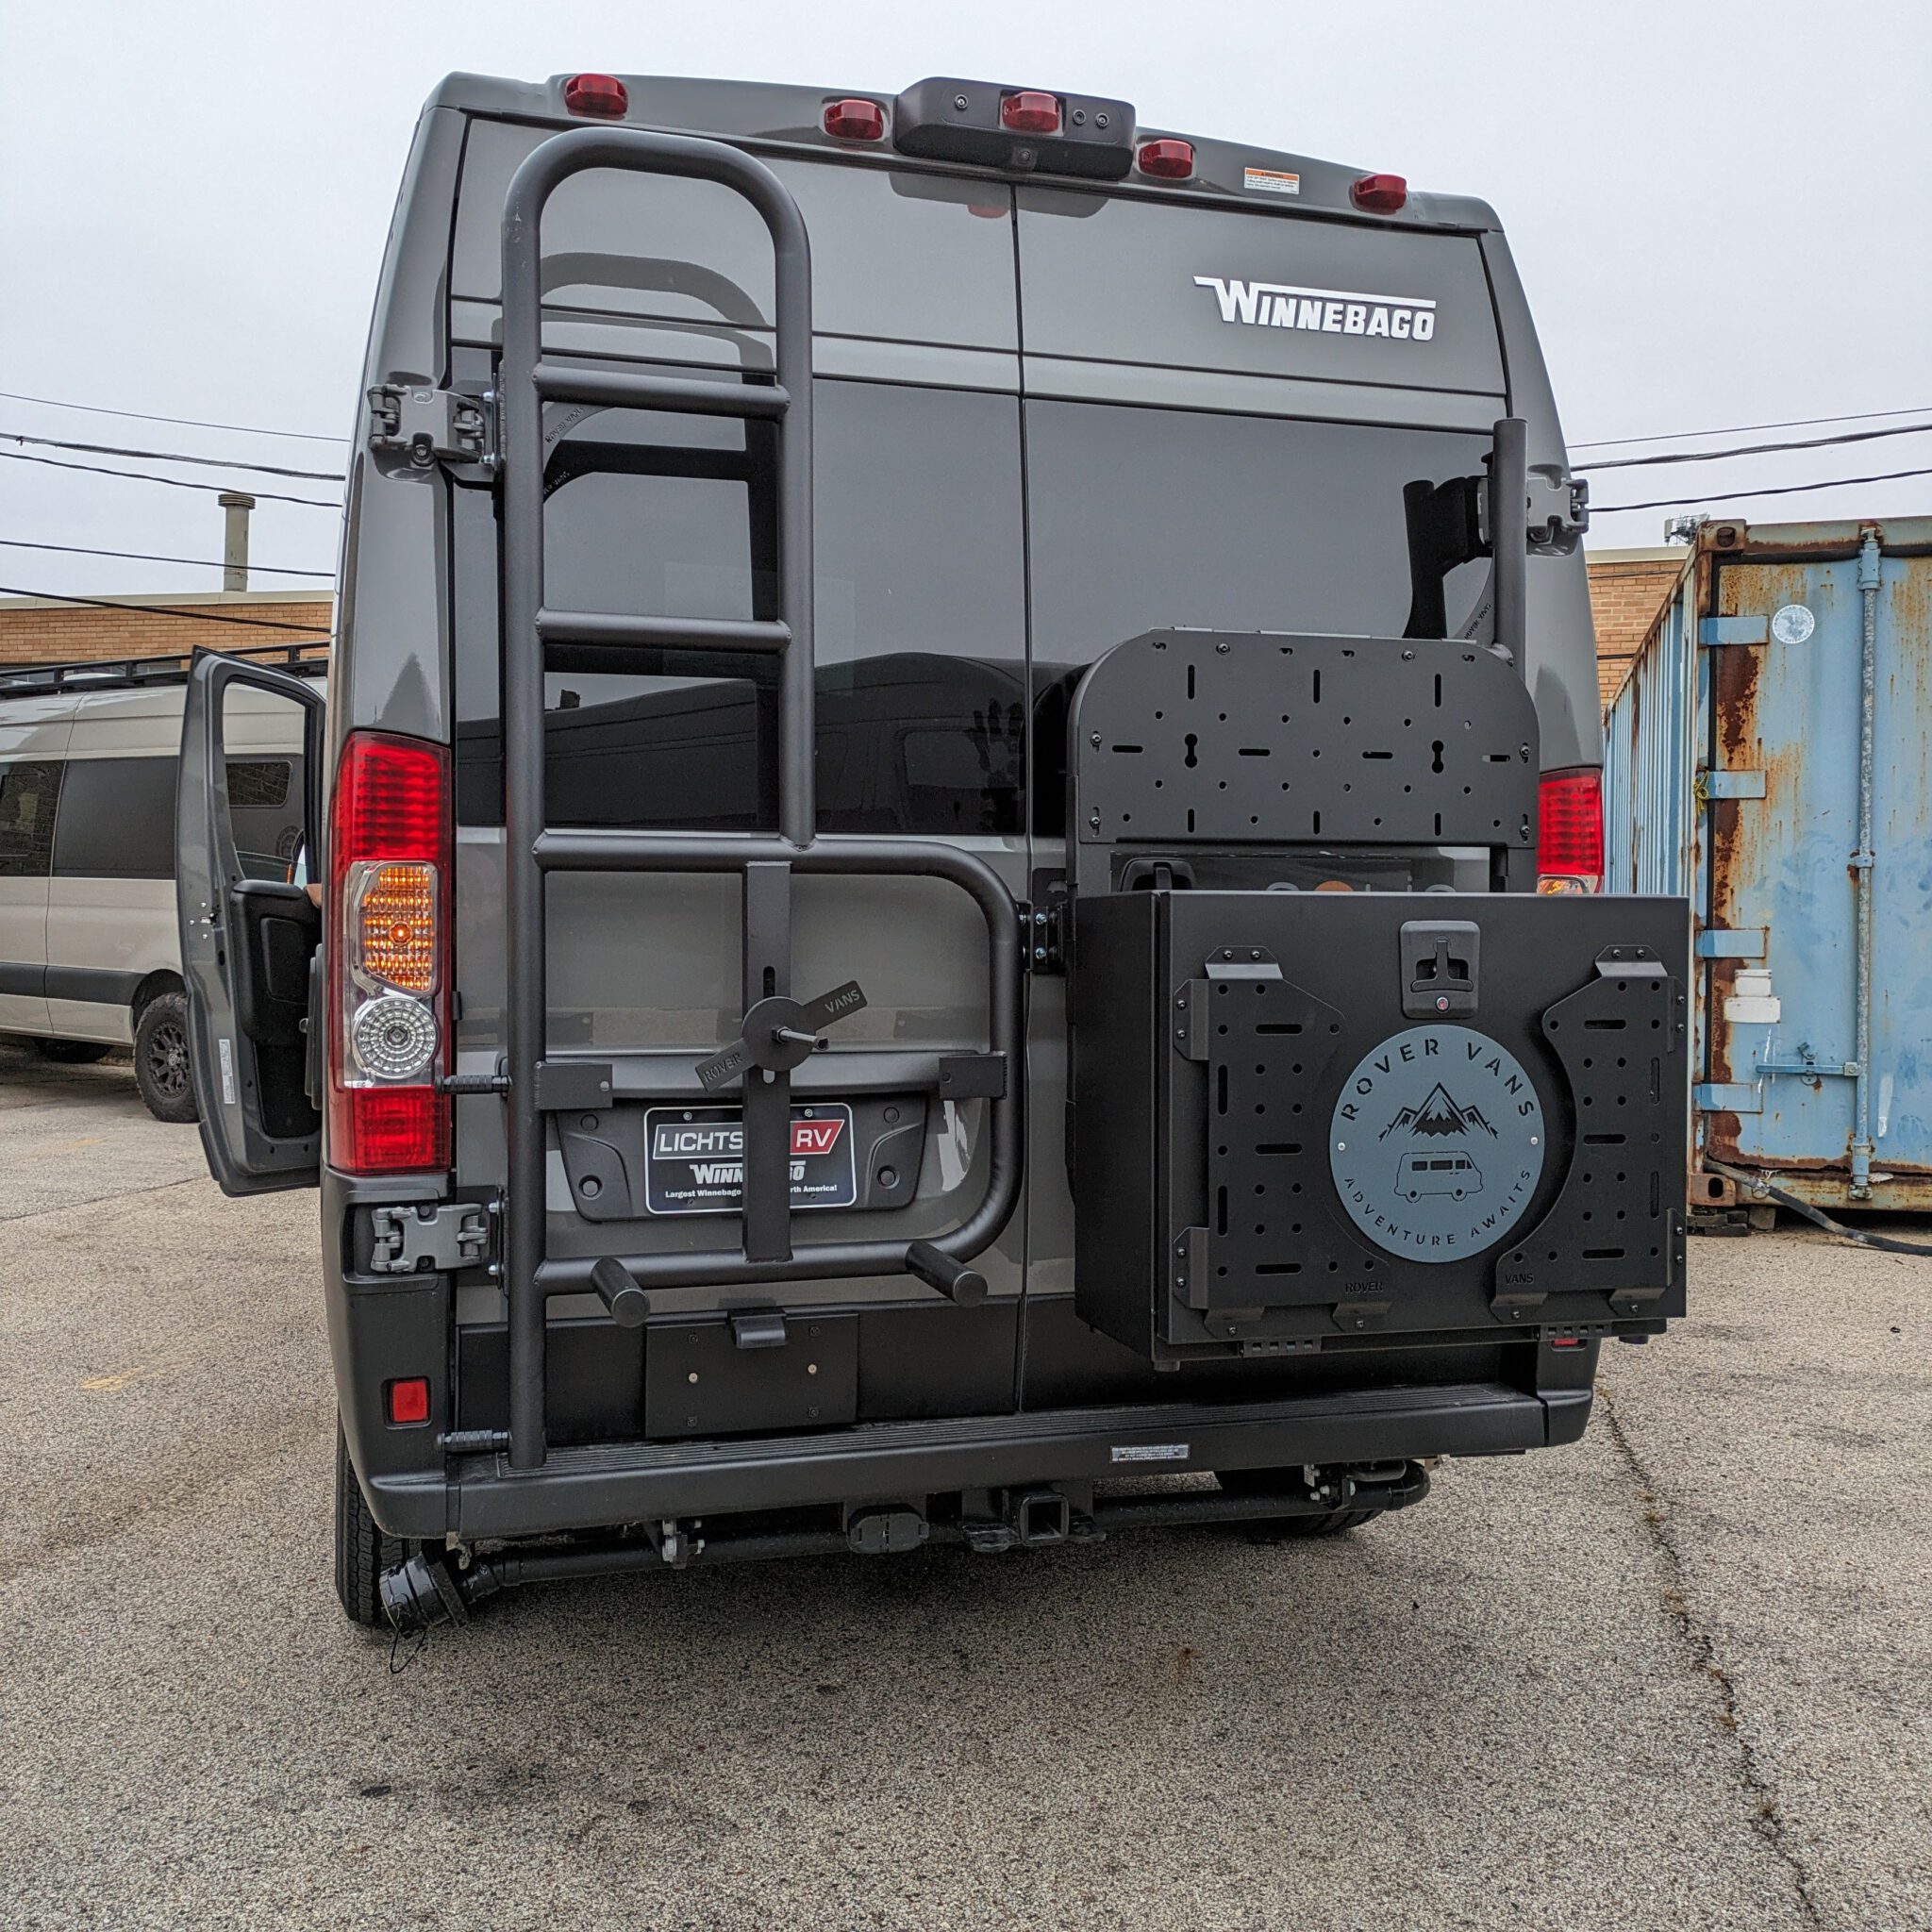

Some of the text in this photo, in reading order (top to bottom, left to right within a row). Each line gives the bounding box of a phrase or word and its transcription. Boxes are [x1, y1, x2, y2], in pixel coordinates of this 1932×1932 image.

[1193, 275, 1437, 341] WINNEBAGO
[703, 989, 860, 1083] ROVER VANS
[1341, 1039, 1535, 1121] ROVER VANS
[660, 1128, 832, 1152] LICHTS RV
[665, 1191, 696, 1199] Largest
[697, 1189, 741, 1197] Winnebago
[803, 1184, 838, 1192] America!
[1343, 1170, 1531, 1246] ADVENTURE AWAITS
[1345, 1273, 1534, 1293] ROVER VANS
